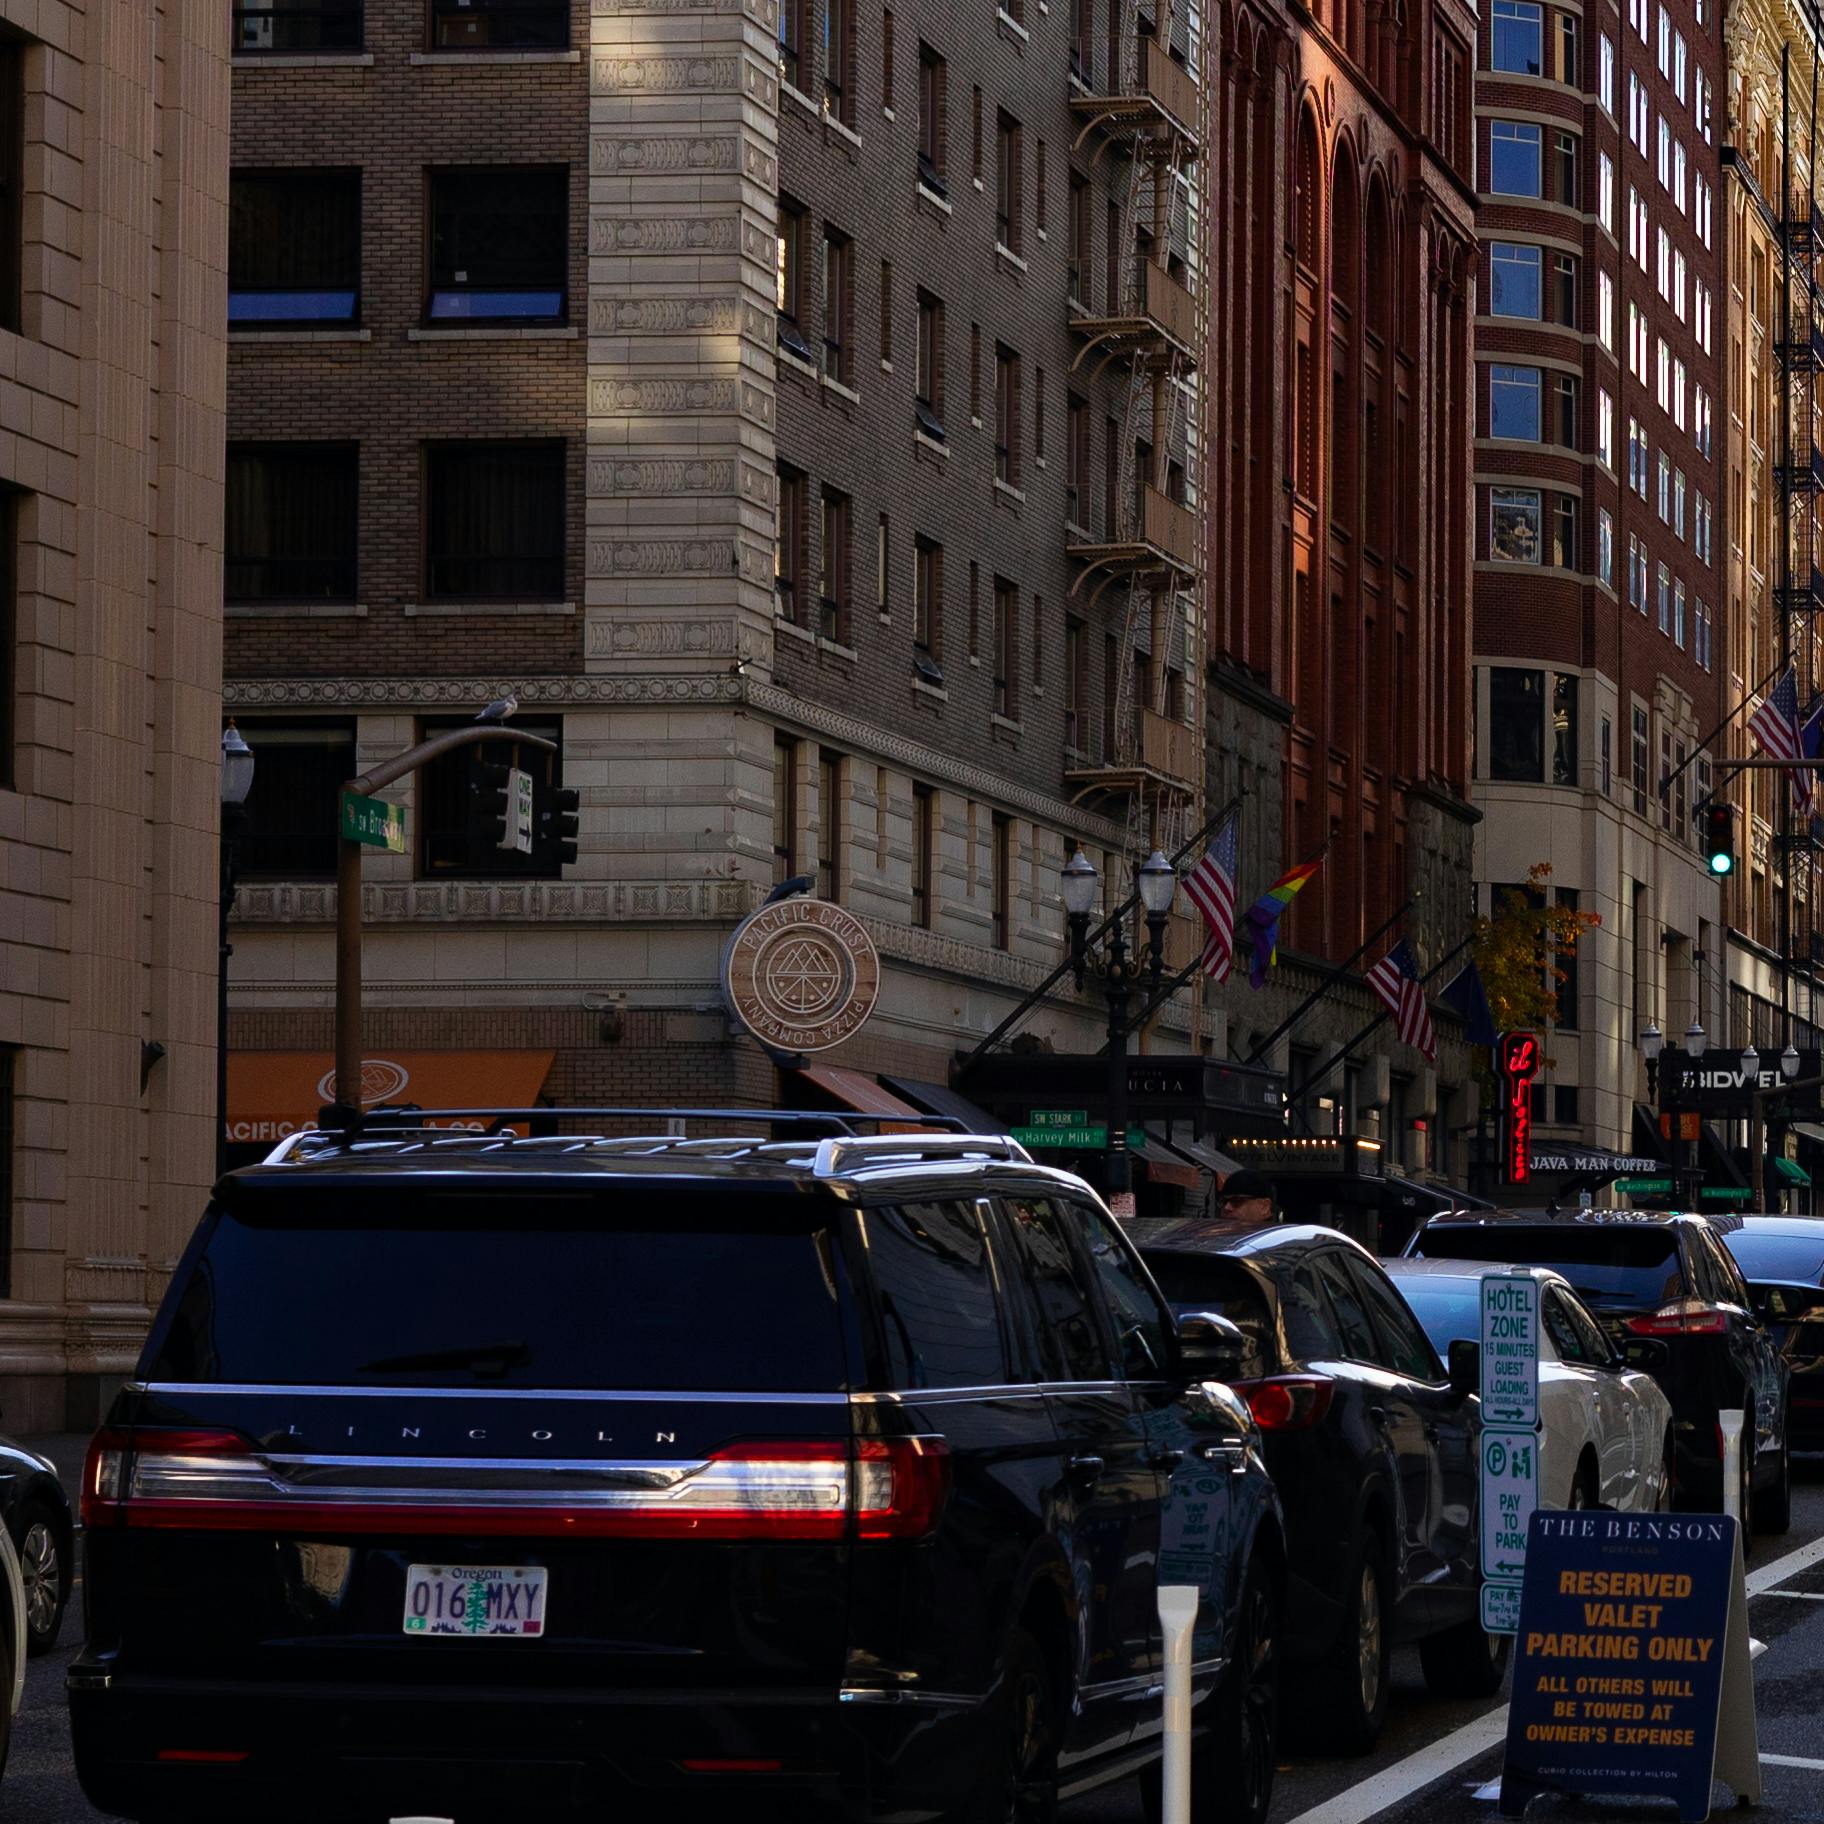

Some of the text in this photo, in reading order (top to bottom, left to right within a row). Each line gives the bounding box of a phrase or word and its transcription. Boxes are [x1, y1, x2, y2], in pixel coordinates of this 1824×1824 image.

[519, 776, 531, 796] ONE
[519, 798, 531, 819] WAY
[369, 809, 403, 842] Broadway
[742, 903, 871, 956] PACIFIC CRUST
[742, 997, 865, 1044] PIZZA COMPANY
[1128, 1079, 1184, 1092] UCIA
[1034, 1113, 1072, 1125] SW STARK
[225, 1121, 296, 1141] ACIFIC
[1026, 1131, 1063, 1146] Harvey
[1068, 1131, 1091, 1144] Milk
[1529, 1156, 1657, 1173] JAVA MAN COFFEE
[1487, 1289, 1533, 1312] HOTEL
[1491, 1316, 1528, 1338] ZONE
[1485, 1342, 1535, 1358] 15 MINUTES
[1495, 1362, 1524, 1376] GUEST
[1490, 1380, 1529, 1394] LOADING
[1485, 1396, 1495, 1404] ALL
[289, 1424, 677, 1444] LINCOLN
[1499, 1493, 1521, 1511] PAY
[1503, 1513, 1518, 1530] TO
[1539, 1518, 1723, 1542] THE BENSON
[1495, 1532, 1526, 1550] PARK
[1600, 1545, 1659, 1555] PORTLAND
[451, 1567, 503, 1582] Oregon
[1558, 1570, 1693, 1598] RESERVED
[413, 1581, 540, 1621] 016 MXY
[1490, 1590, 1504, 1601] PAY
[1583, 1602, 1663, 1629] VALET
[1526, 1632, 1713, 1663] PARKING ONLY
[1536, 1676, 1695, 1697] ALL OTHERS WILL
[1552, 1700, 1674, 1721] BE TOWED AT
[1525, 1723, 1695, 1747] OWNER'S EXPENSE
[1537, 1766, 1678, 1778] CURIO COLLECTION BY HILTON
